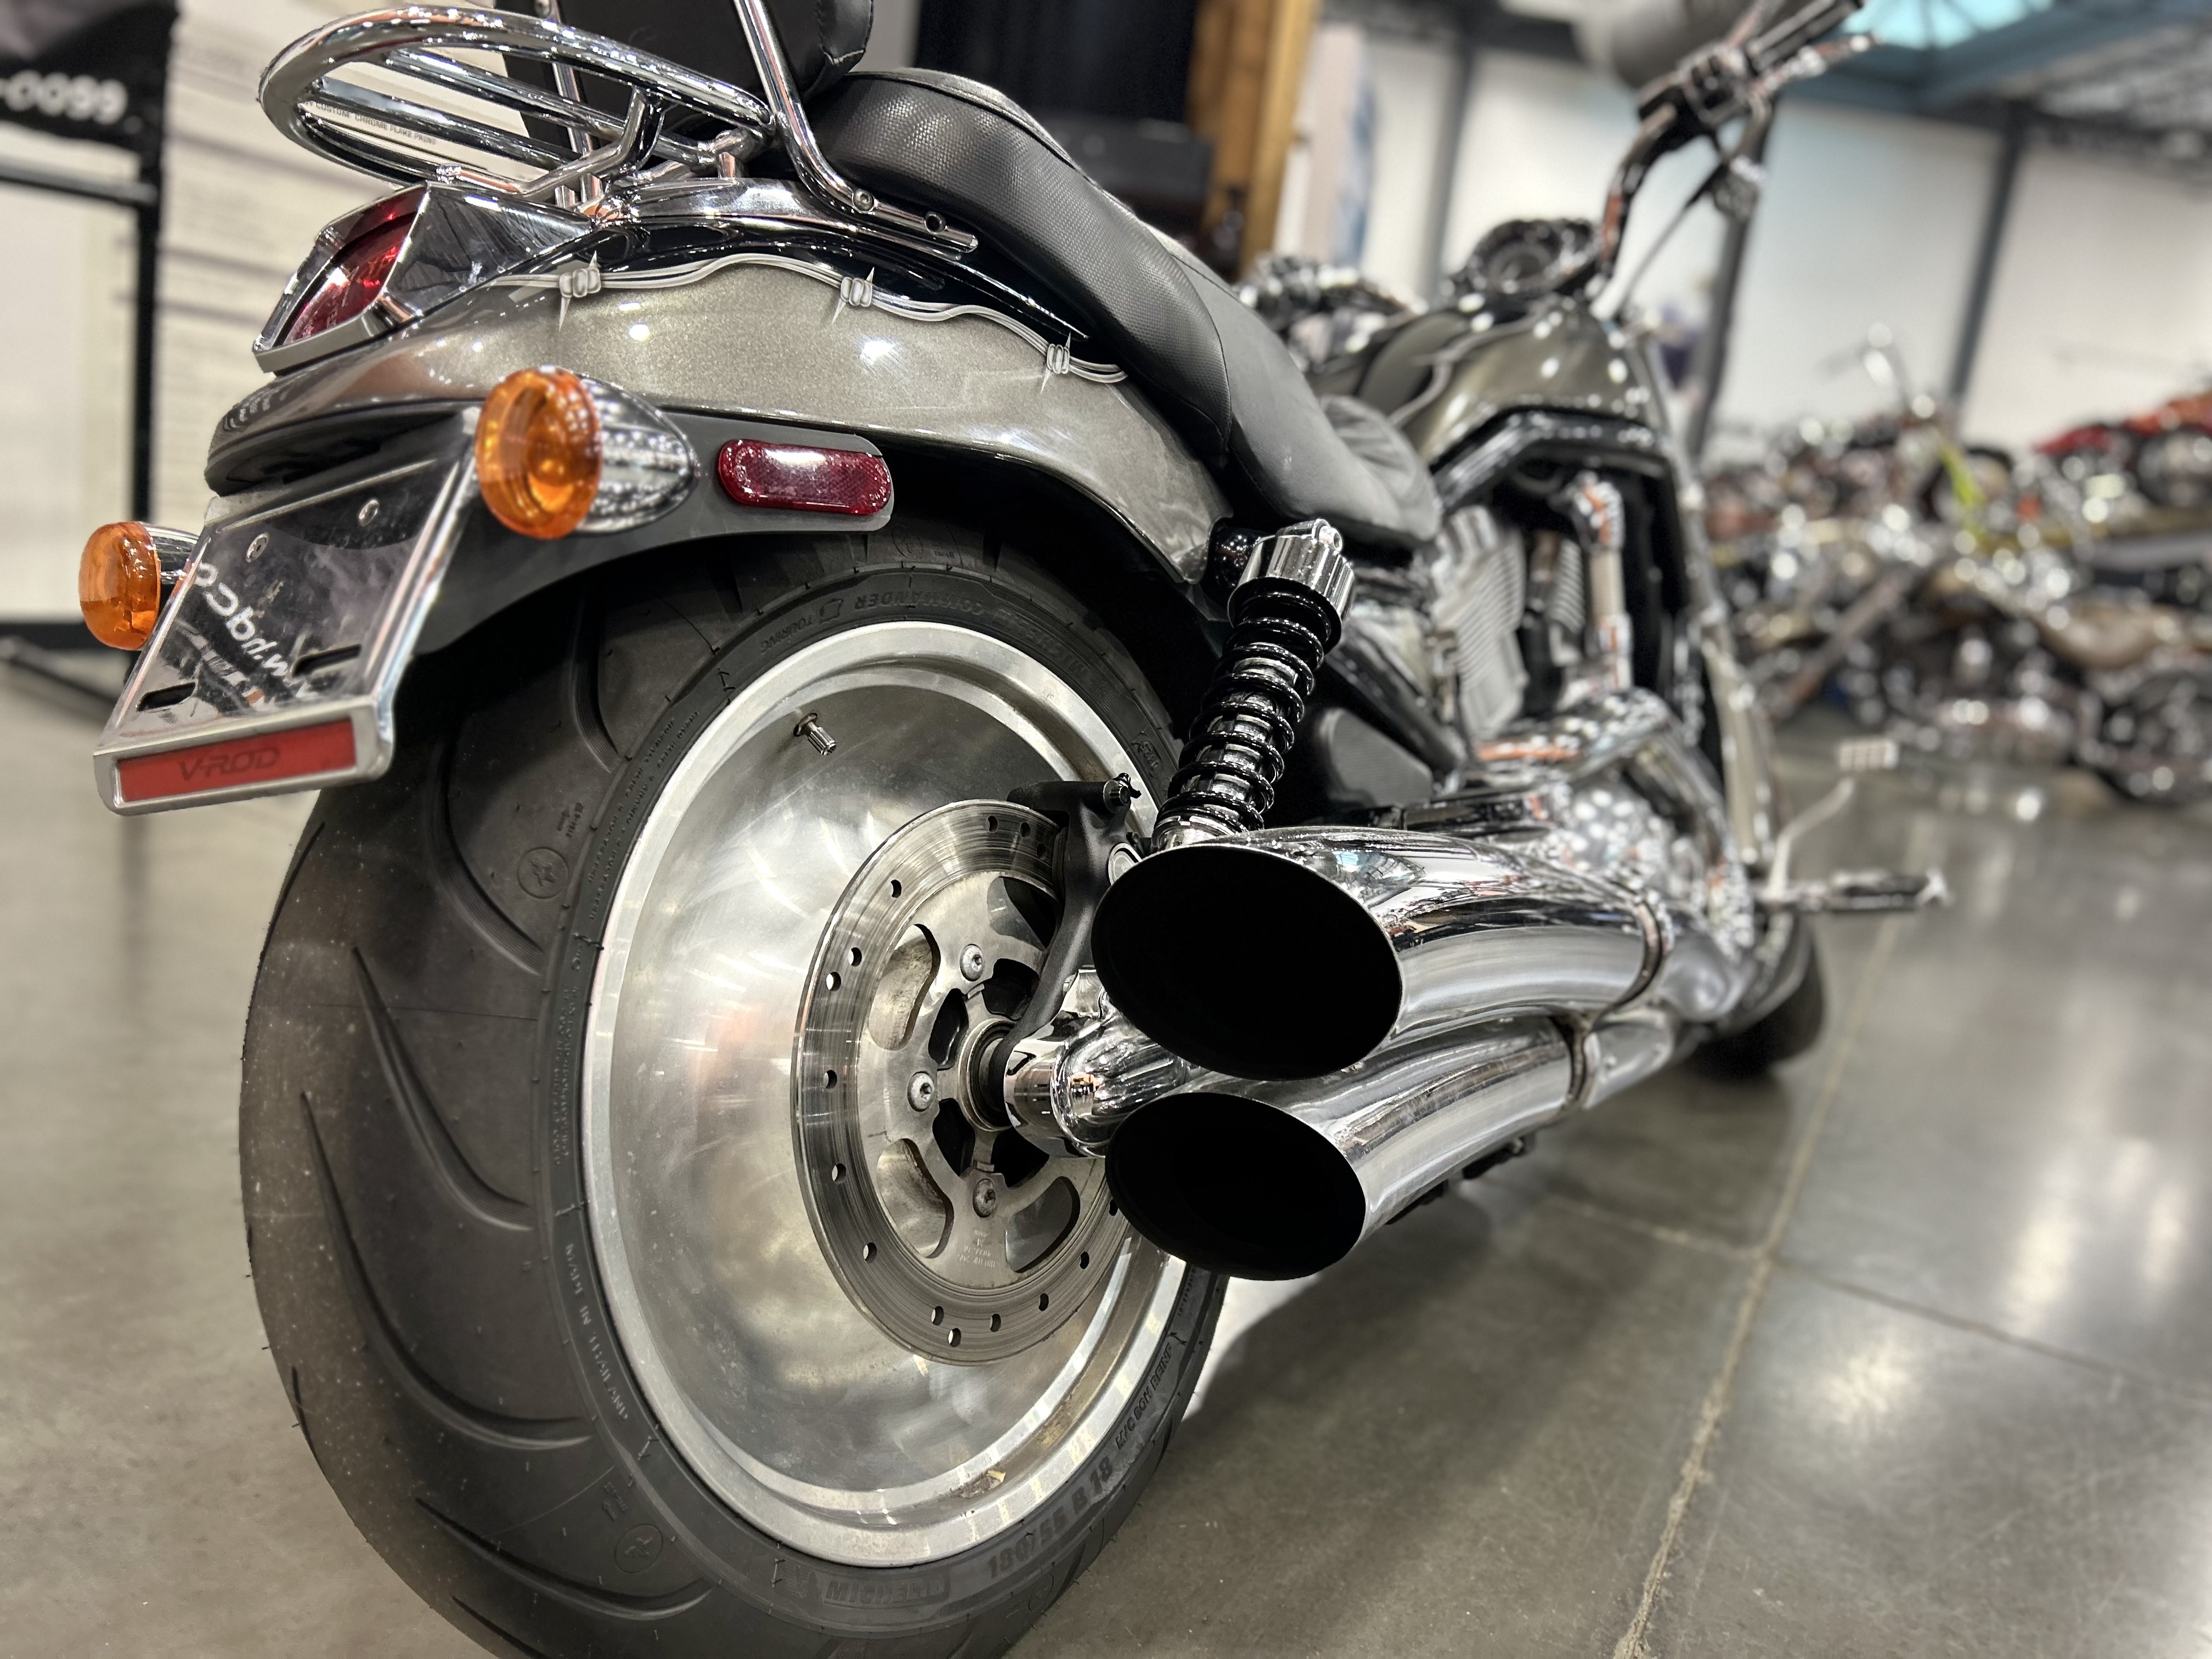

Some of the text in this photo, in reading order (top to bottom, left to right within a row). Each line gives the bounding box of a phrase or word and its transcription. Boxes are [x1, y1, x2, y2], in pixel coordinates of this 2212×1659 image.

[854, 591, 985, 615] COMMANDER
[760, 615, 817, 653] TOURING
[178, 747, 281, 781] V-ROD
[566, 1243, 629, 1421] MADE IN THAILAND
[1150, 1345, 1173, 1387] REINF
[987, 1512, 1073, 1580] 180/55
[1091, 1457, 1113, 1495] 18
